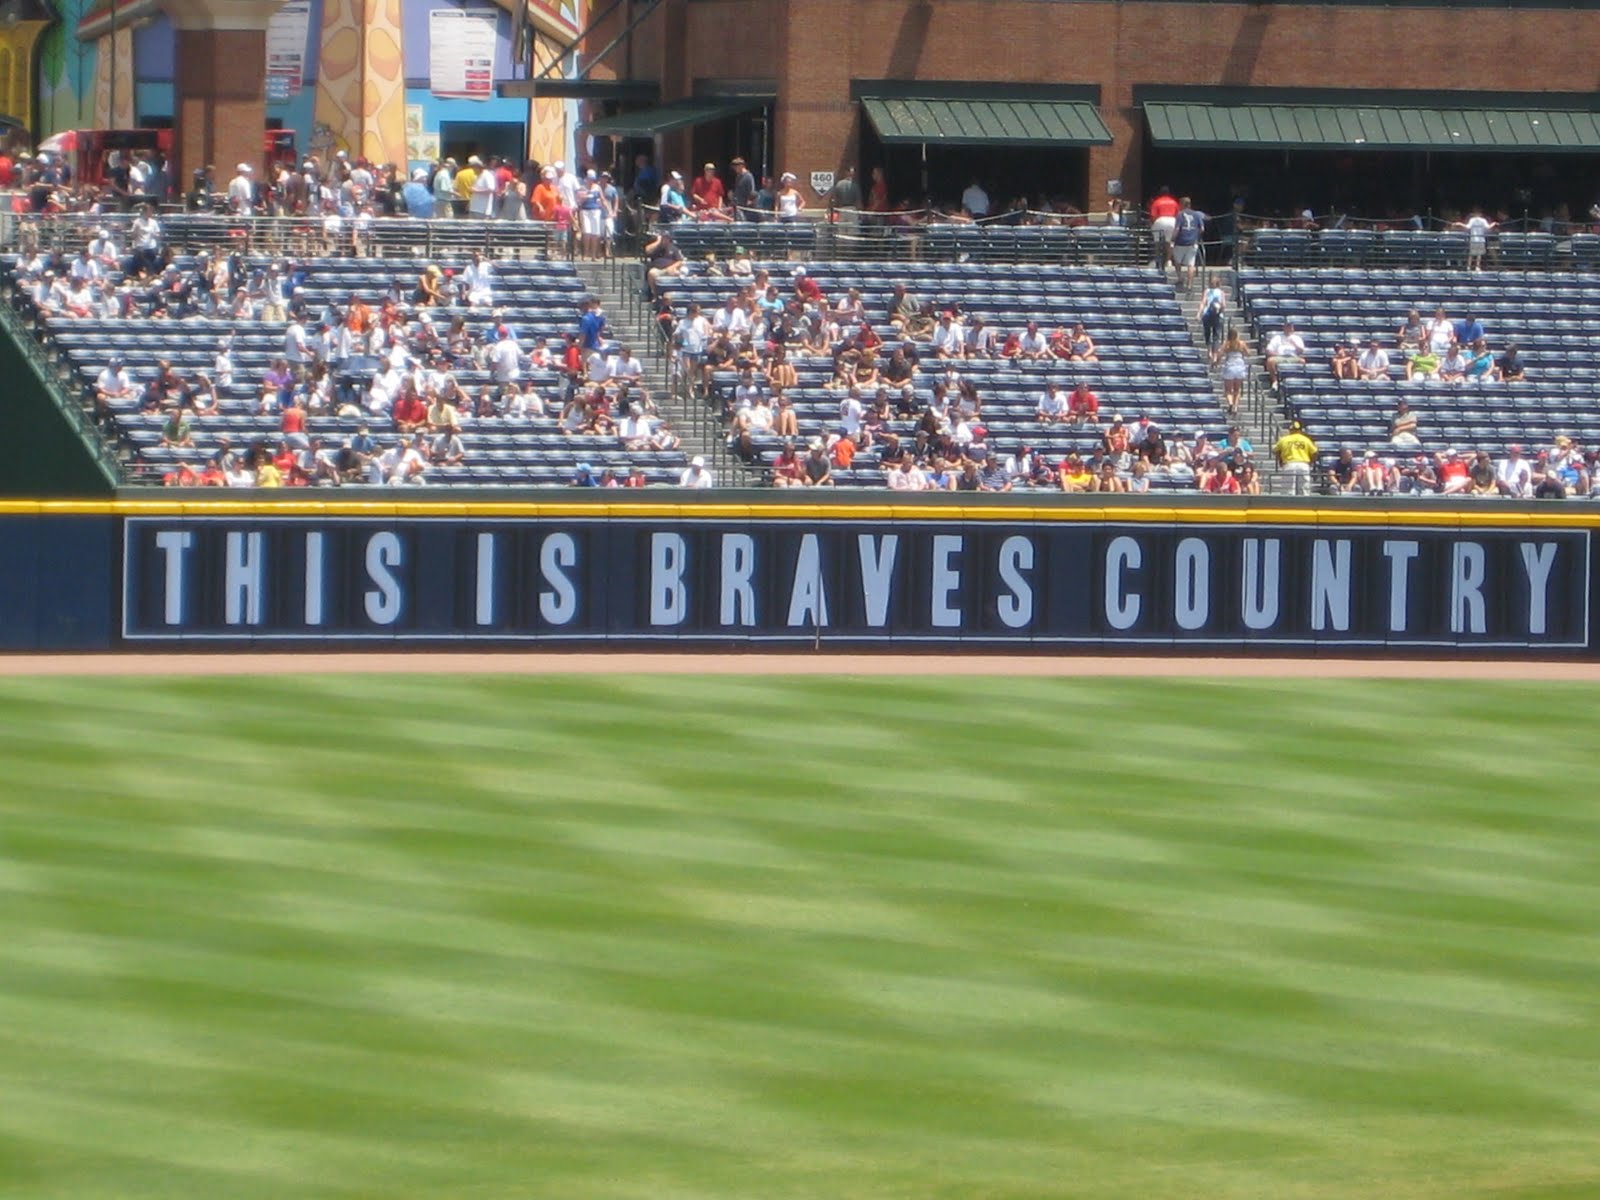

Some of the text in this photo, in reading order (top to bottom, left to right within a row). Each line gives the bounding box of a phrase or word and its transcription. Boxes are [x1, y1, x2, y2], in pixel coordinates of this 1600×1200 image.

[813, 173, 832, 182] 460
[155, 531, 1557, 635] THIS IS BRAVES COUNTRY
